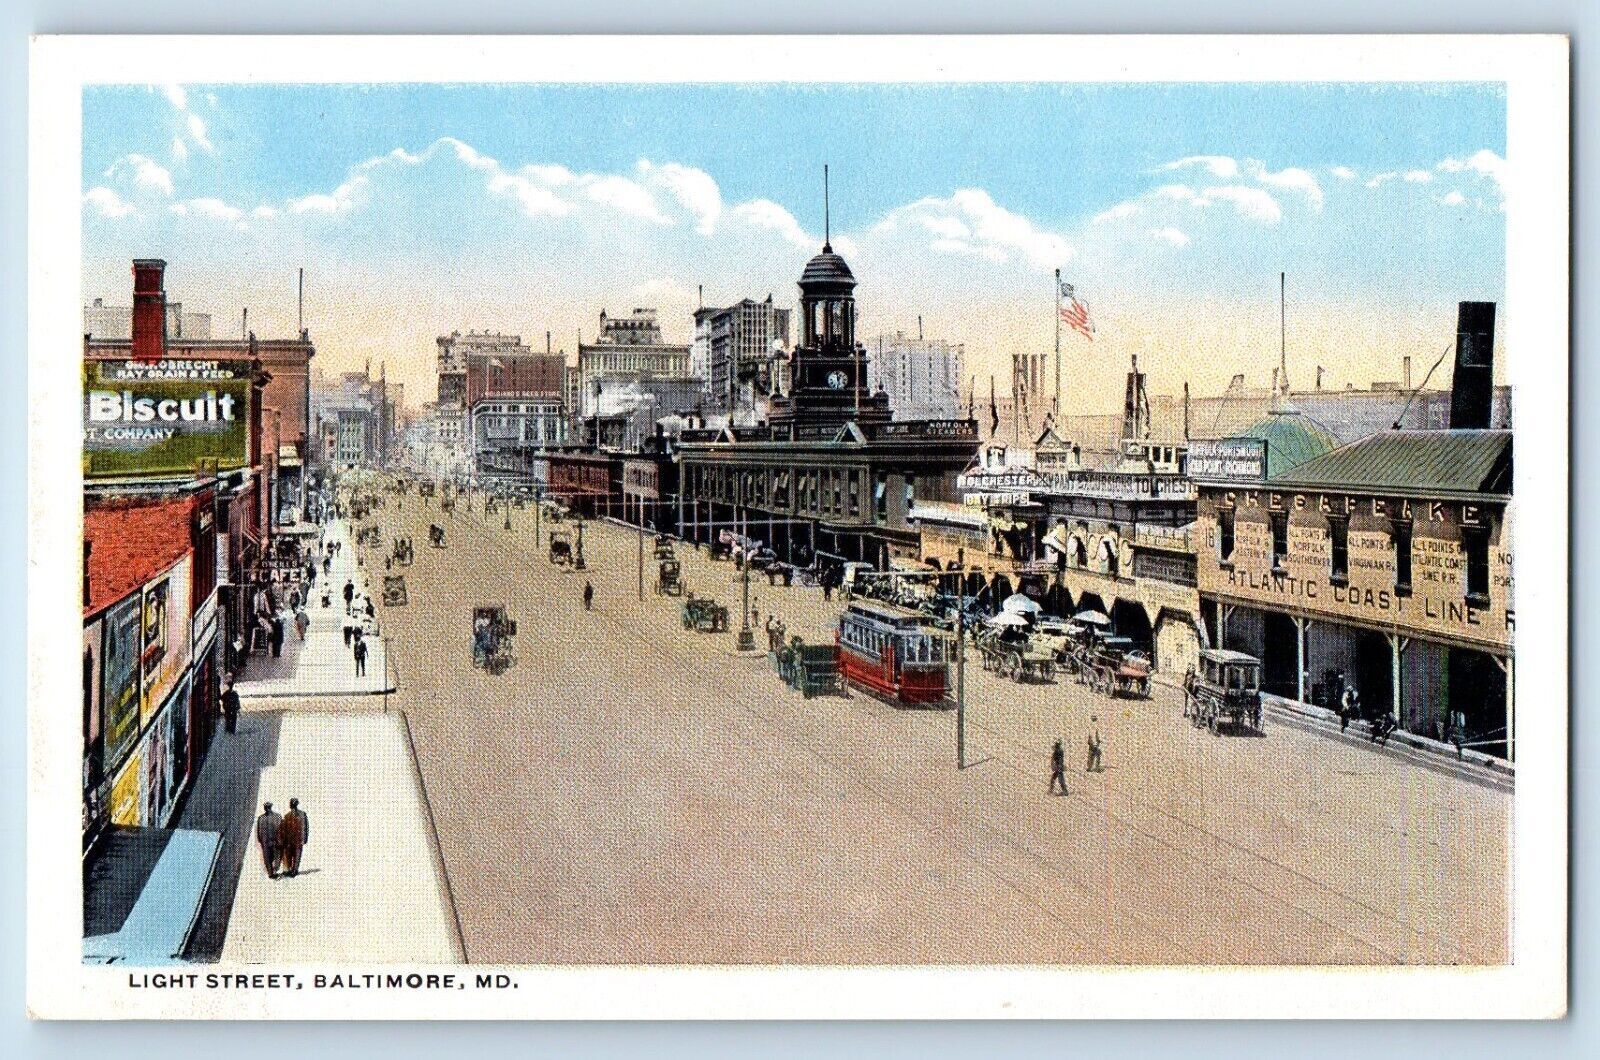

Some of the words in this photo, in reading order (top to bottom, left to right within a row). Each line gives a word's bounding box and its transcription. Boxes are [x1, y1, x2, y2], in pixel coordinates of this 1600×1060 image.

[159, 360, 219, 370] OBRECHT
[89, 389, 236, 422] Biscuit
[104, 427, 175, 440] COMPANY
[926, 428, 974, 436] STEAMERS
[1205, 526, 1215, 549] 18
[1428, 540, 1454, 555] POINTS
[1227, 570, 1318, 600] ATLANTIC
[1333, 583, 1404, 612] COAST
[1425, 597, 1481, 626] LINE
